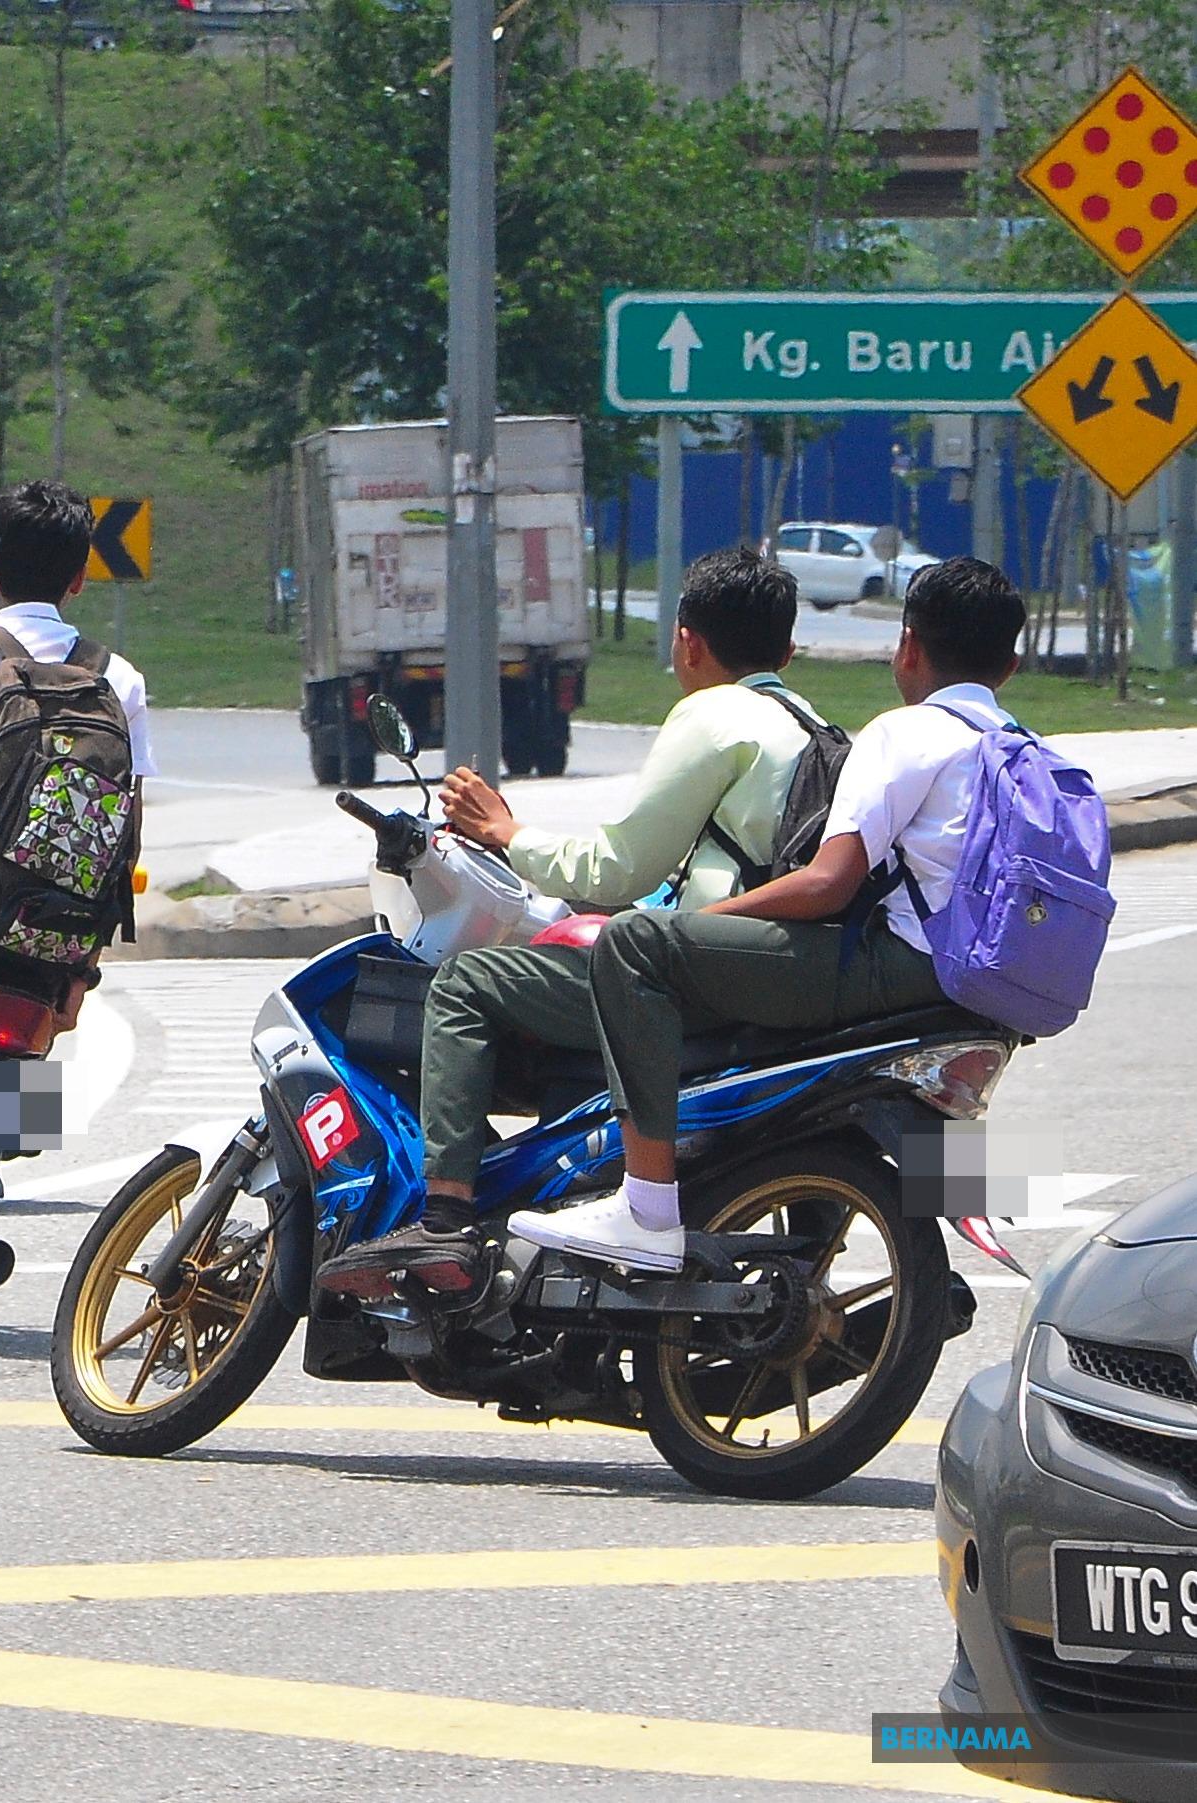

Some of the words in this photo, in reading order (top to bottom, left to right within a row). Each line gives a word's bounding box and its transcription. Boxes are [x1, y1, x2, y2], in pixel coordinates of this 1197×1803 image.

[743, 330, 821, 379] Kg.
[847, 330, 973, 373] Baru
[1001, 330, 1068, 374] Ai
[1086, 1563, 1171, 1636] WTG
